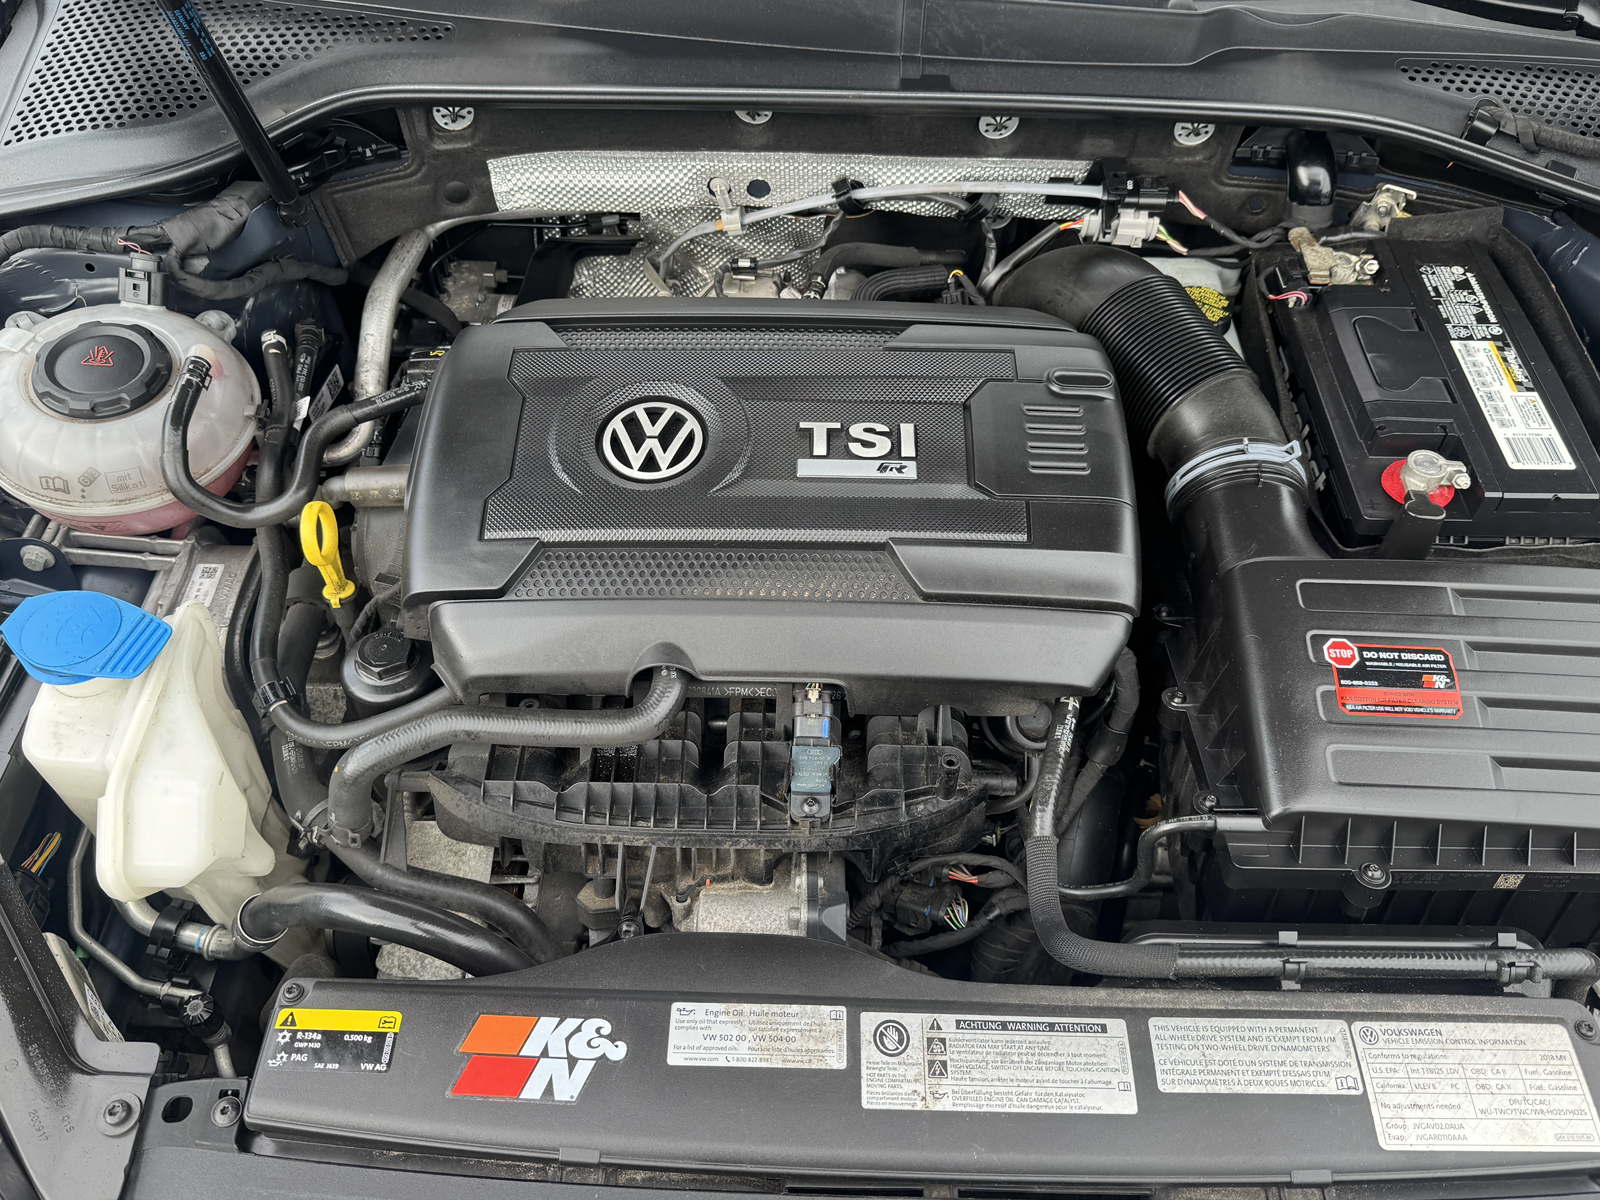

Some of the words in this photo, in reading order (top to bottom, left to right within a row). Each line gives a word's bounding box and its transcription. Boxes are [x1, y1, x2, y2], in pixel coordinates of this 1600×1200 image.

[799, 422, 916, 458] TSI
[877, 462, 908, 476] R
[116, 472, 132, 484] mit
[111, 479, 144, 494] Silikat
[1329, 649, 1353, 658] STOP
[705, 1009, 731, 1018] Engine
[960, 1021, 1002, 1030] ACHTUNG
[1007, 1022, 1049, 1031] WARNING
[1054, 1023, 1101, 1032] ATTENTION
[296, 1032, 322, 1040] R-134a
[364, 1035, 373, 1043] kg
[519, 1058, 596, 1100] N
[1393, 1102, 1434, 1111] adjustments
